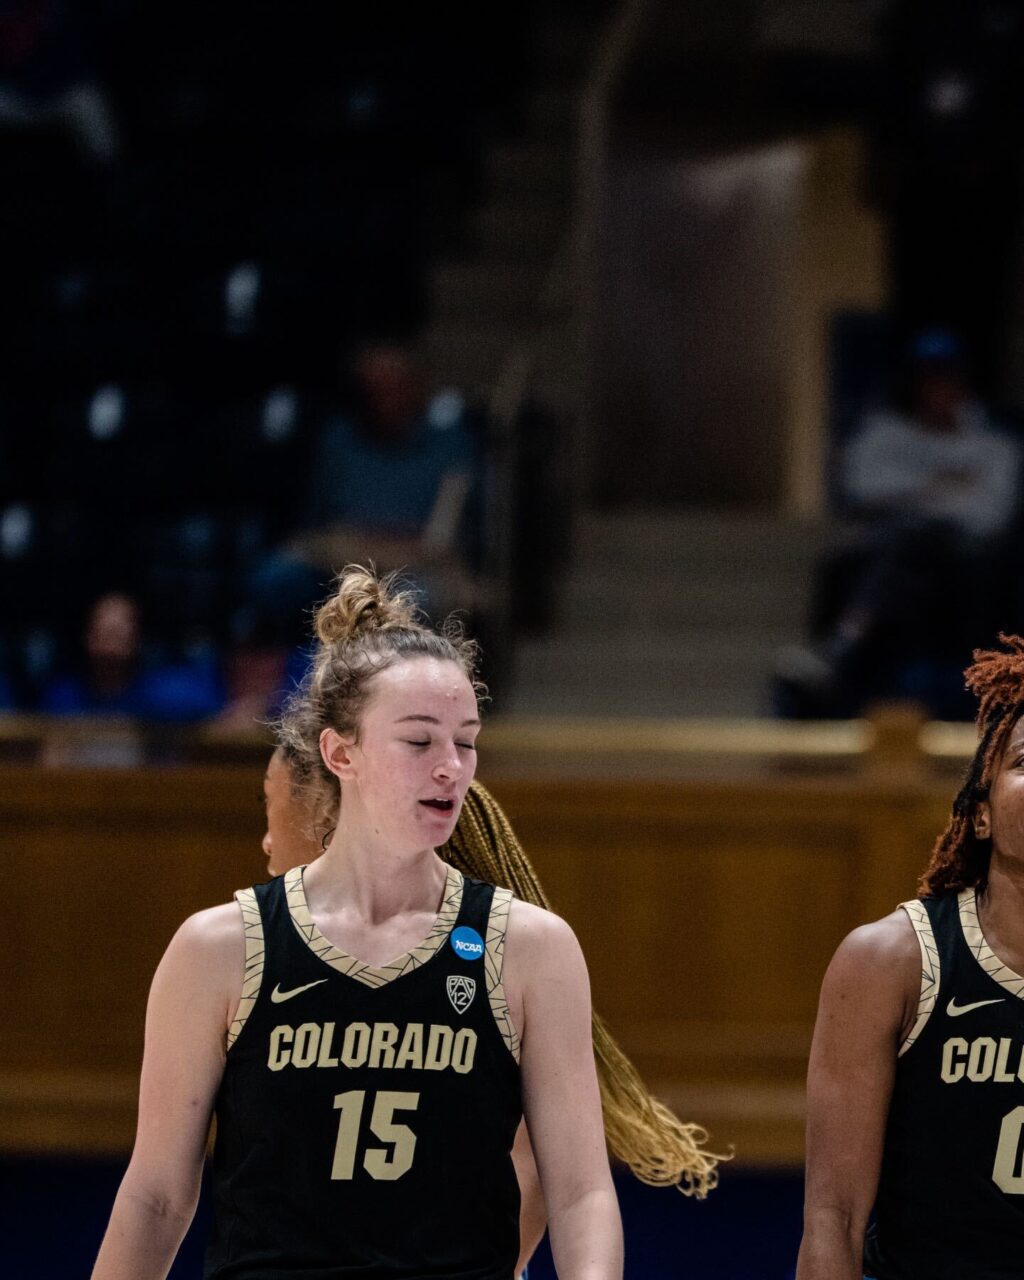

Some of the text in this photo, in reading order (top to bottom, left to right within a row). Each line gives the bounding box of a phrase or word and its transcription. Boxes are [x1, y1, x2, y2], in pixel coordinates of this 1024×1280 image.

[455, 939, 483, 953] NCAA
[453, 991, 467, 1006] 12
[267, 1022, 478, 1075] COLORADO
[330, 1090, 420, 1181] 15
